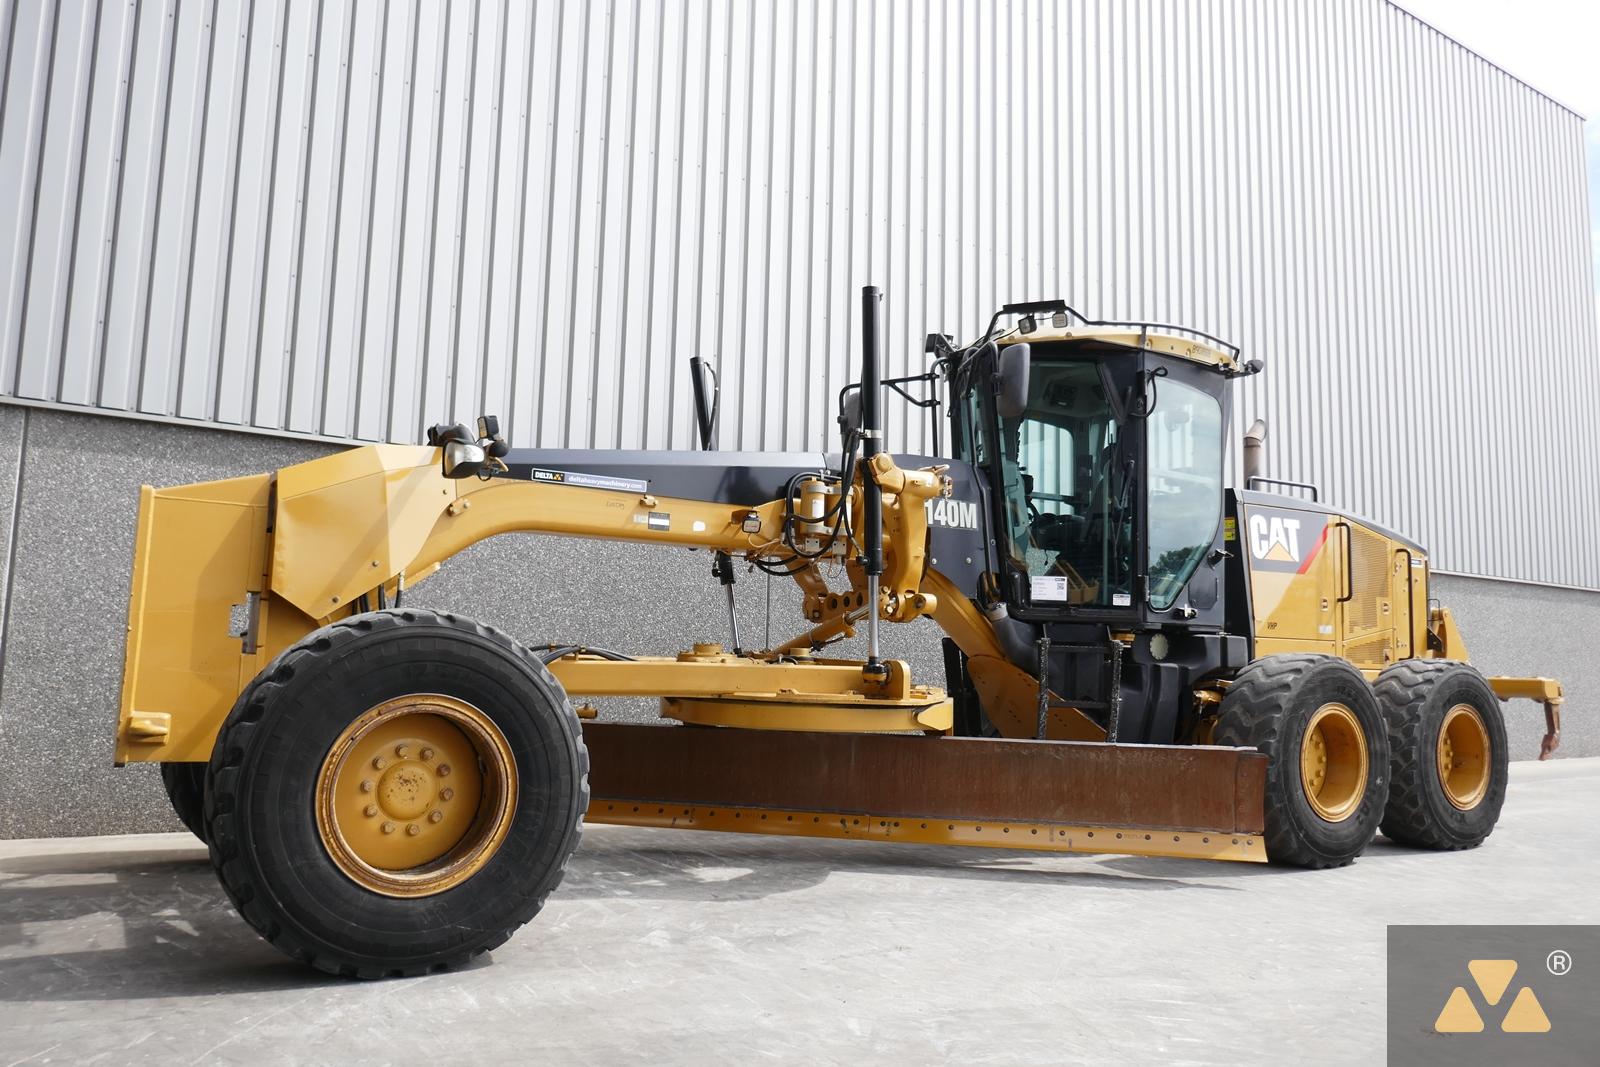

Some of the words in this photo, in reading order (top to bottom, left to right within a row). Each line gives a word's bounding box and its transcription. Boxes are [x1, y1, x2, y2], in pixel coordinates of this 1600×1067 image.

[534, 471, 554, 480] DELTA
[924, 498, 977, 529] 140M
[1249, 514, 1301, 562] CAT
